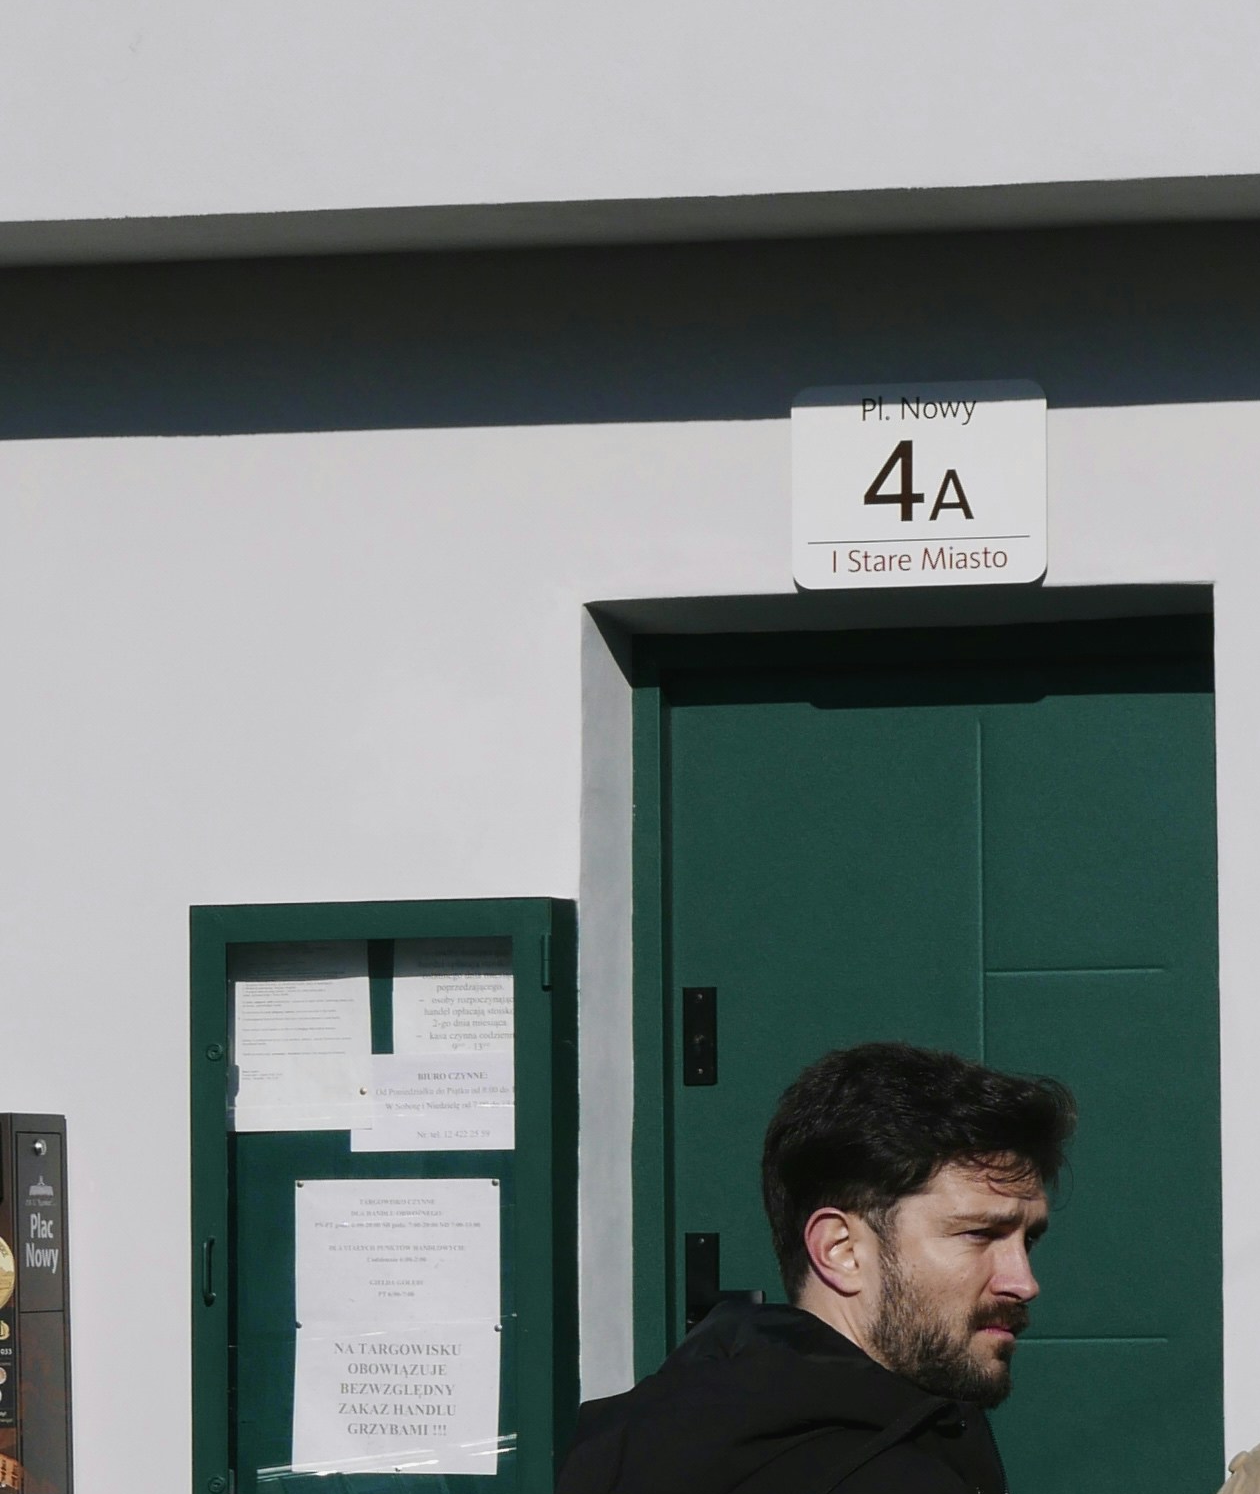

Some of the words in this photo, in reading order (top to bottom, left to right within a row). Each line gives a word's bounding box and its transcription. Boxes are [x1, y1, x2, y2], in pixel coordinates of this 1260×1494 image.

[862, 396, 890, 421] Pl.
[901, 396, 977, 425] Nowy
[848, 549, 912, 572] Stare
[922, 546, 1008, 570] Miasto
[417, 1072, 446, 1081] BIURO
[30, 1212, 54, 1239] Plac
[25, 1242, 59, 1274] Nowy
[334, 1342, 355, 1355] NA
[358, 1343, 462, 1356] TARGOWISKU
[347, 1362, 447, 1378] OBOWIĄZUJE
[340, 1382, 455, 1398] BEZWZGLĘDNY
[338, 1402, 391, 1415] ZAKAZ
[393, 1404, 456, 1416] HANDLU
[347, 1423, 428, 1436] GRZYBAMI
